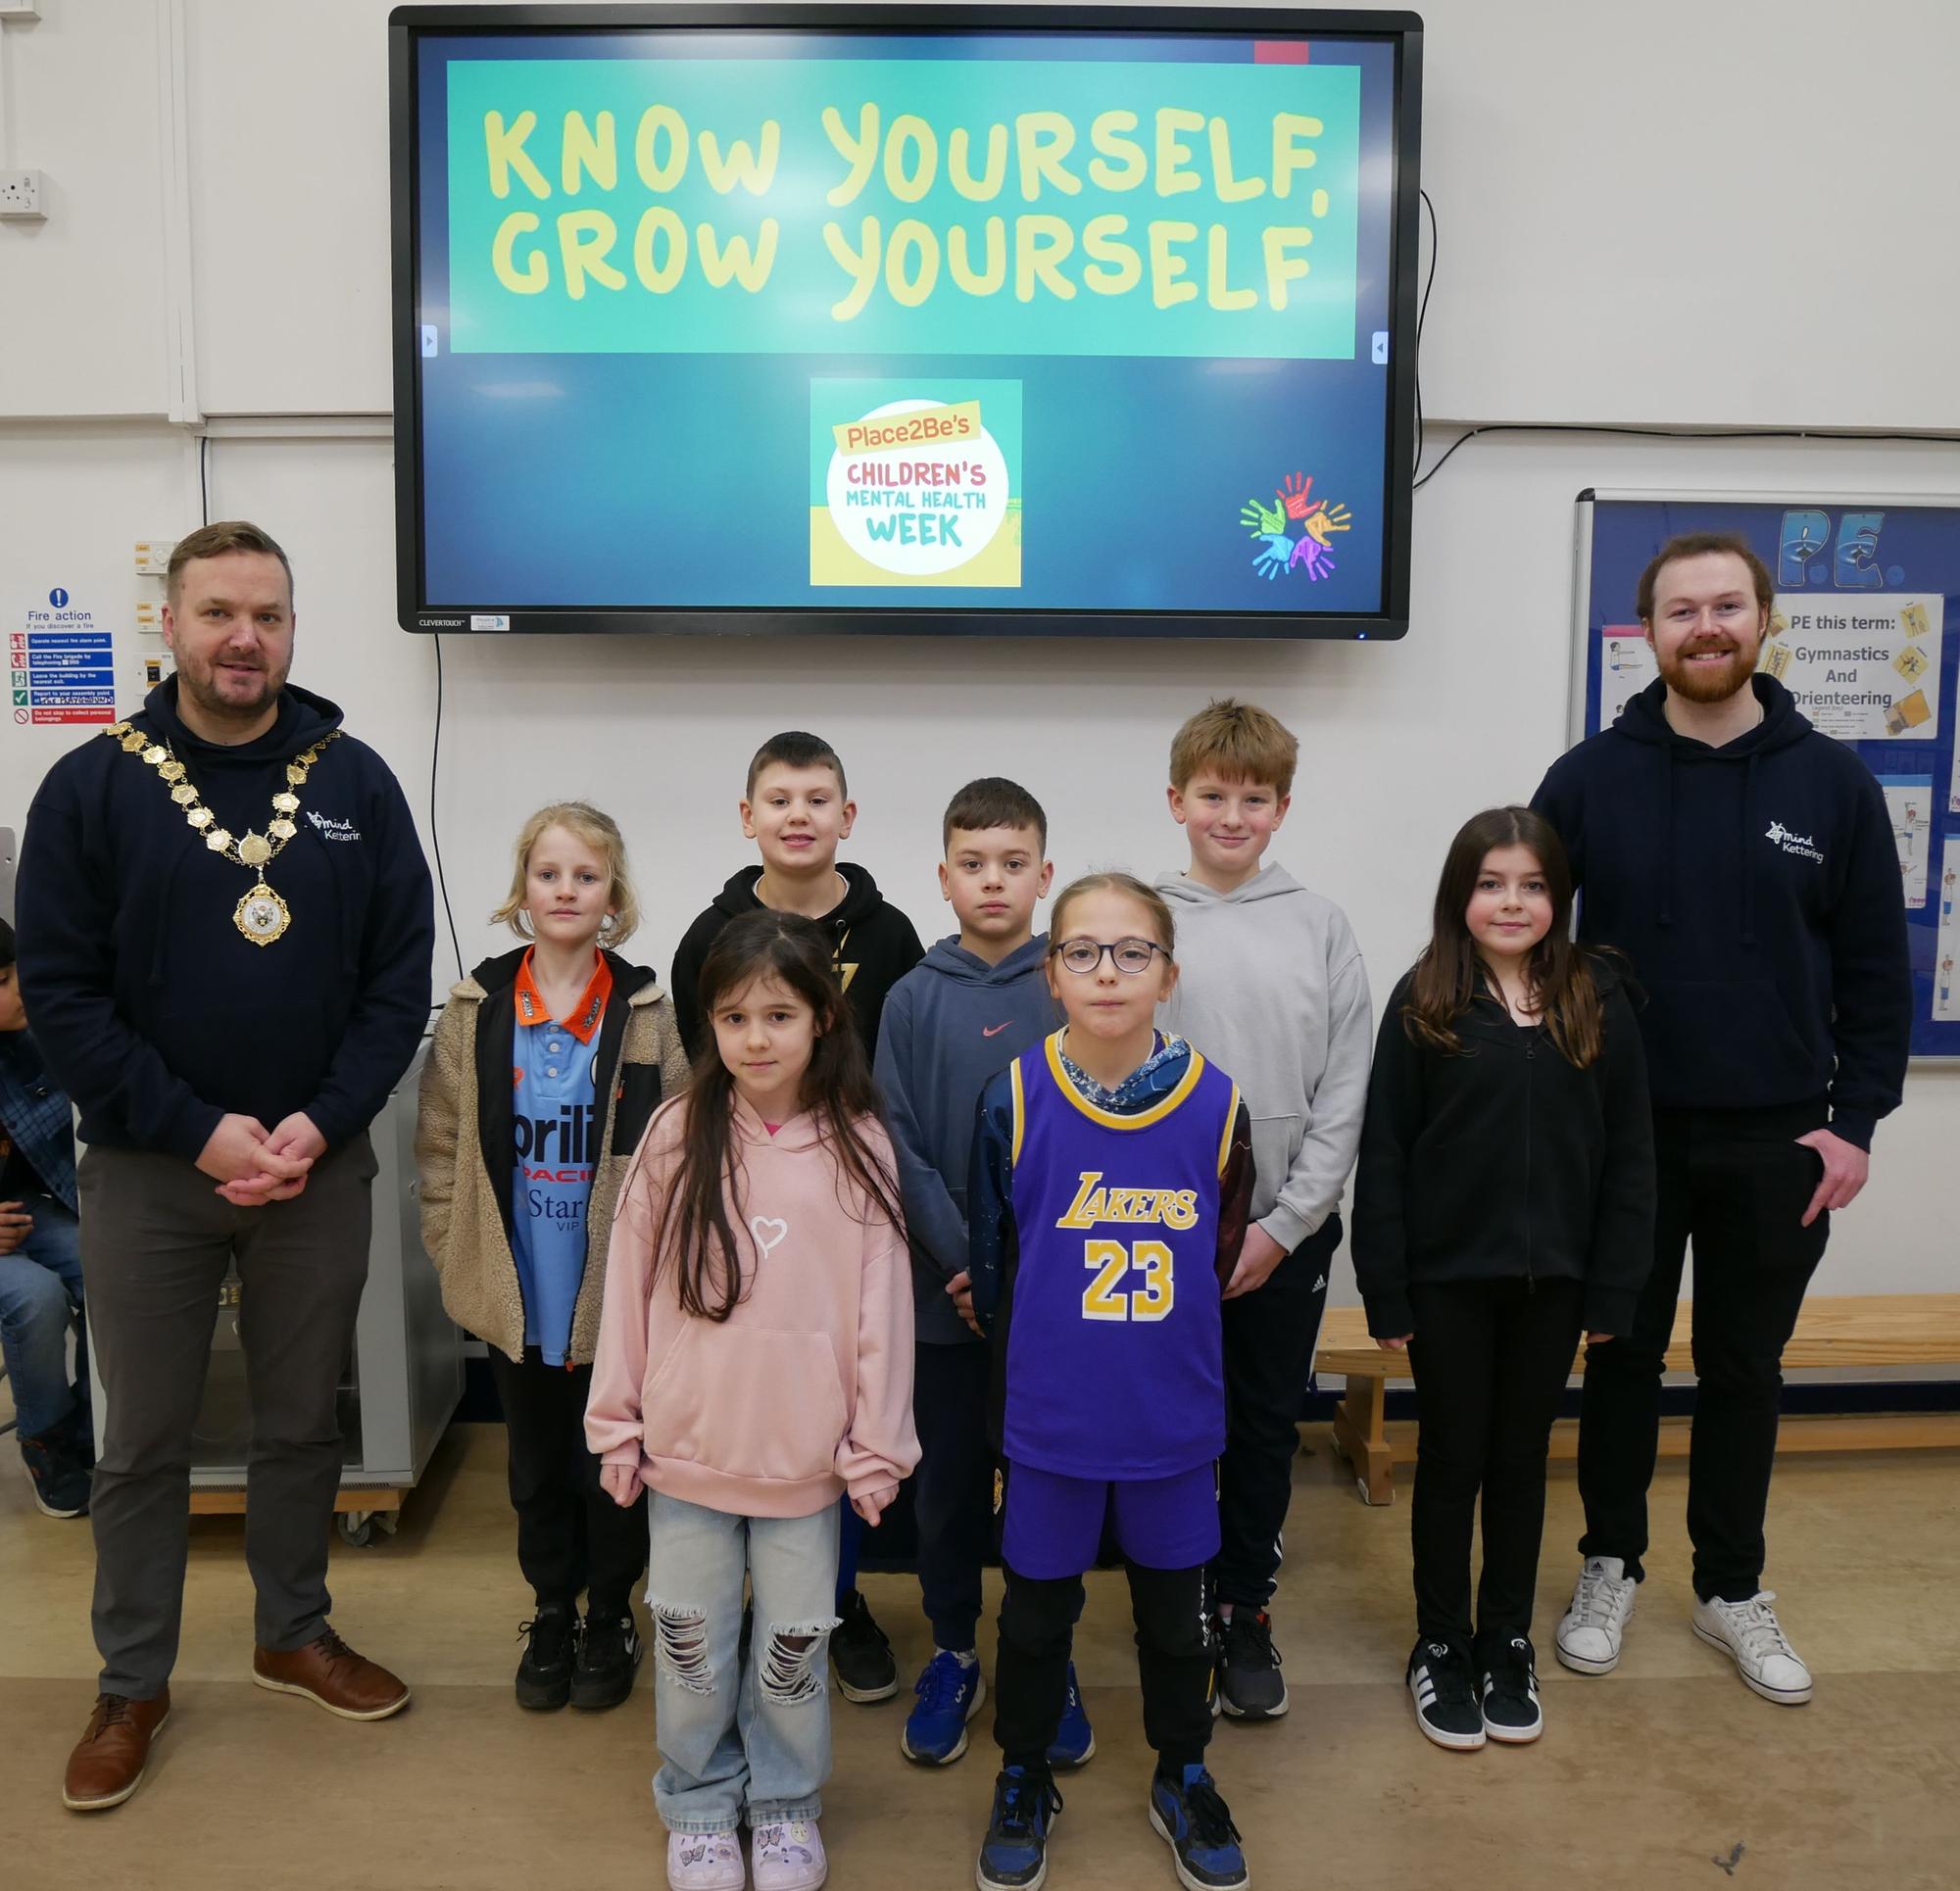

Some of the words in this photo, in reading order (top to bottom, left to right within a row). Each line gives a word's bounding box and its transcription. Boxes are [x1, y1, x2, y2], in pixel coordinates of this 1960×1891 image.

[484, 104, 781, 200] KNOW
[821, 102, 1329, 218] YOURSELF,
[492, 206, 779, 301] GROW
[822, 214, 1313, 322] YOURSELF
[848, 414, 970, 449] Place2Be's
[847, 461, 987, 487] CHILDREN'S
[846, 490, 915, 509] MENTAL
[922, 491, 986, 509] HEALTH
[866, 512, 962, 548] WEEK
[28, 610, 50, 621] Fire
[55, 610, 91, 621] action
[1790, 615, 1811, 629] PE
[1816, 615, 1846, 630] this
[1851, 616, 1895, 630] term:
[1795, 647, 1889, 664] Gymnastics
[1825, 669, 1857, 682] And
[1792, 691, 1891, 710] Orienteering
[323, 818, 353, 830] mind
[1784, 832, 1814, 847] mind
[1783, 842, 1824, 864] Kettering
[529, 1189, 583, 1219] Star
[1055, 1172, 1199, 1231] LAKERS
[557, 1221, 580, 1232] VIP
[1082, 1239, 1174, 1321] 23
